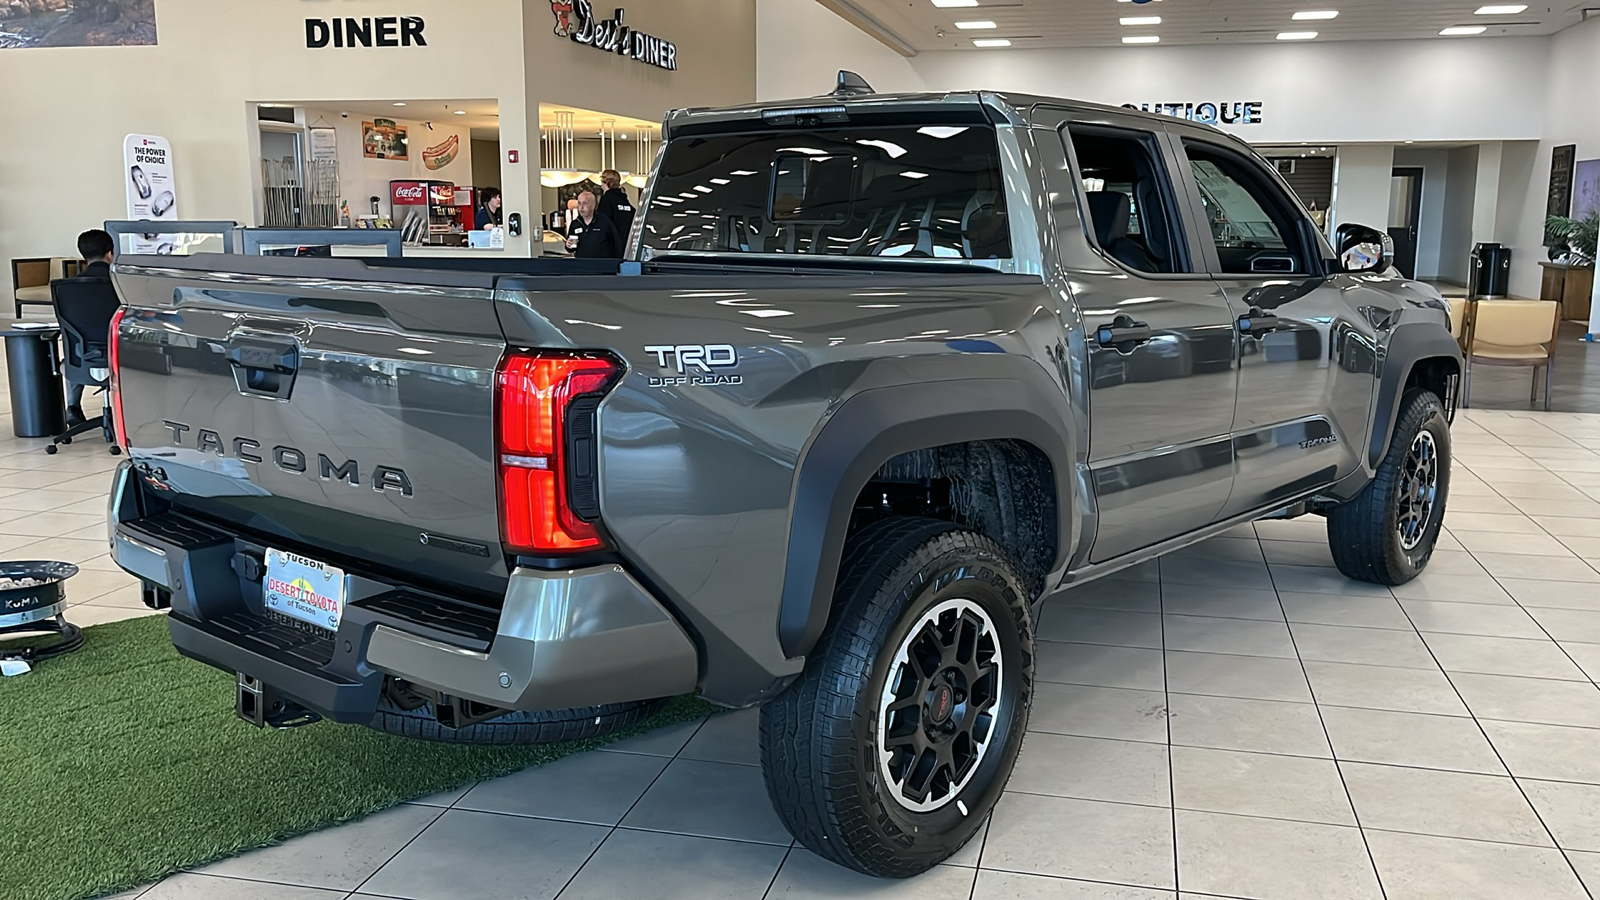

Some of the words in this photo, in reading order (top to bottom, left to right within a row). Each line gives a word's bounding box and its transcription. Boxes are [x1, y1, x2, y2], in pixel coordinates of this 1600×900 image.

[304, 16, 428, 49] DINER
[632, 31, 677, 71] DINER
[134, 146, 146, 155] THE
[146, 147, 166, 157] POWER
[136, 155, 144, 163] OF
[144, 156, 166, 165] CHOICE
[395, 186, 422, 198] Coca-Cola
[644, 344, 737, 373] TRD
[648, 375, 687, 387] OFF
[690, 374, 743, 387] ROAD
[162, 419, 413, 499] TACOMA
[286, 553, 324, 570] TUCSON
[269, 578, 302, 601] DESERT
[304, 590, 338, 613] TOYOTA
[295, 601, 317, 616] Tucson
